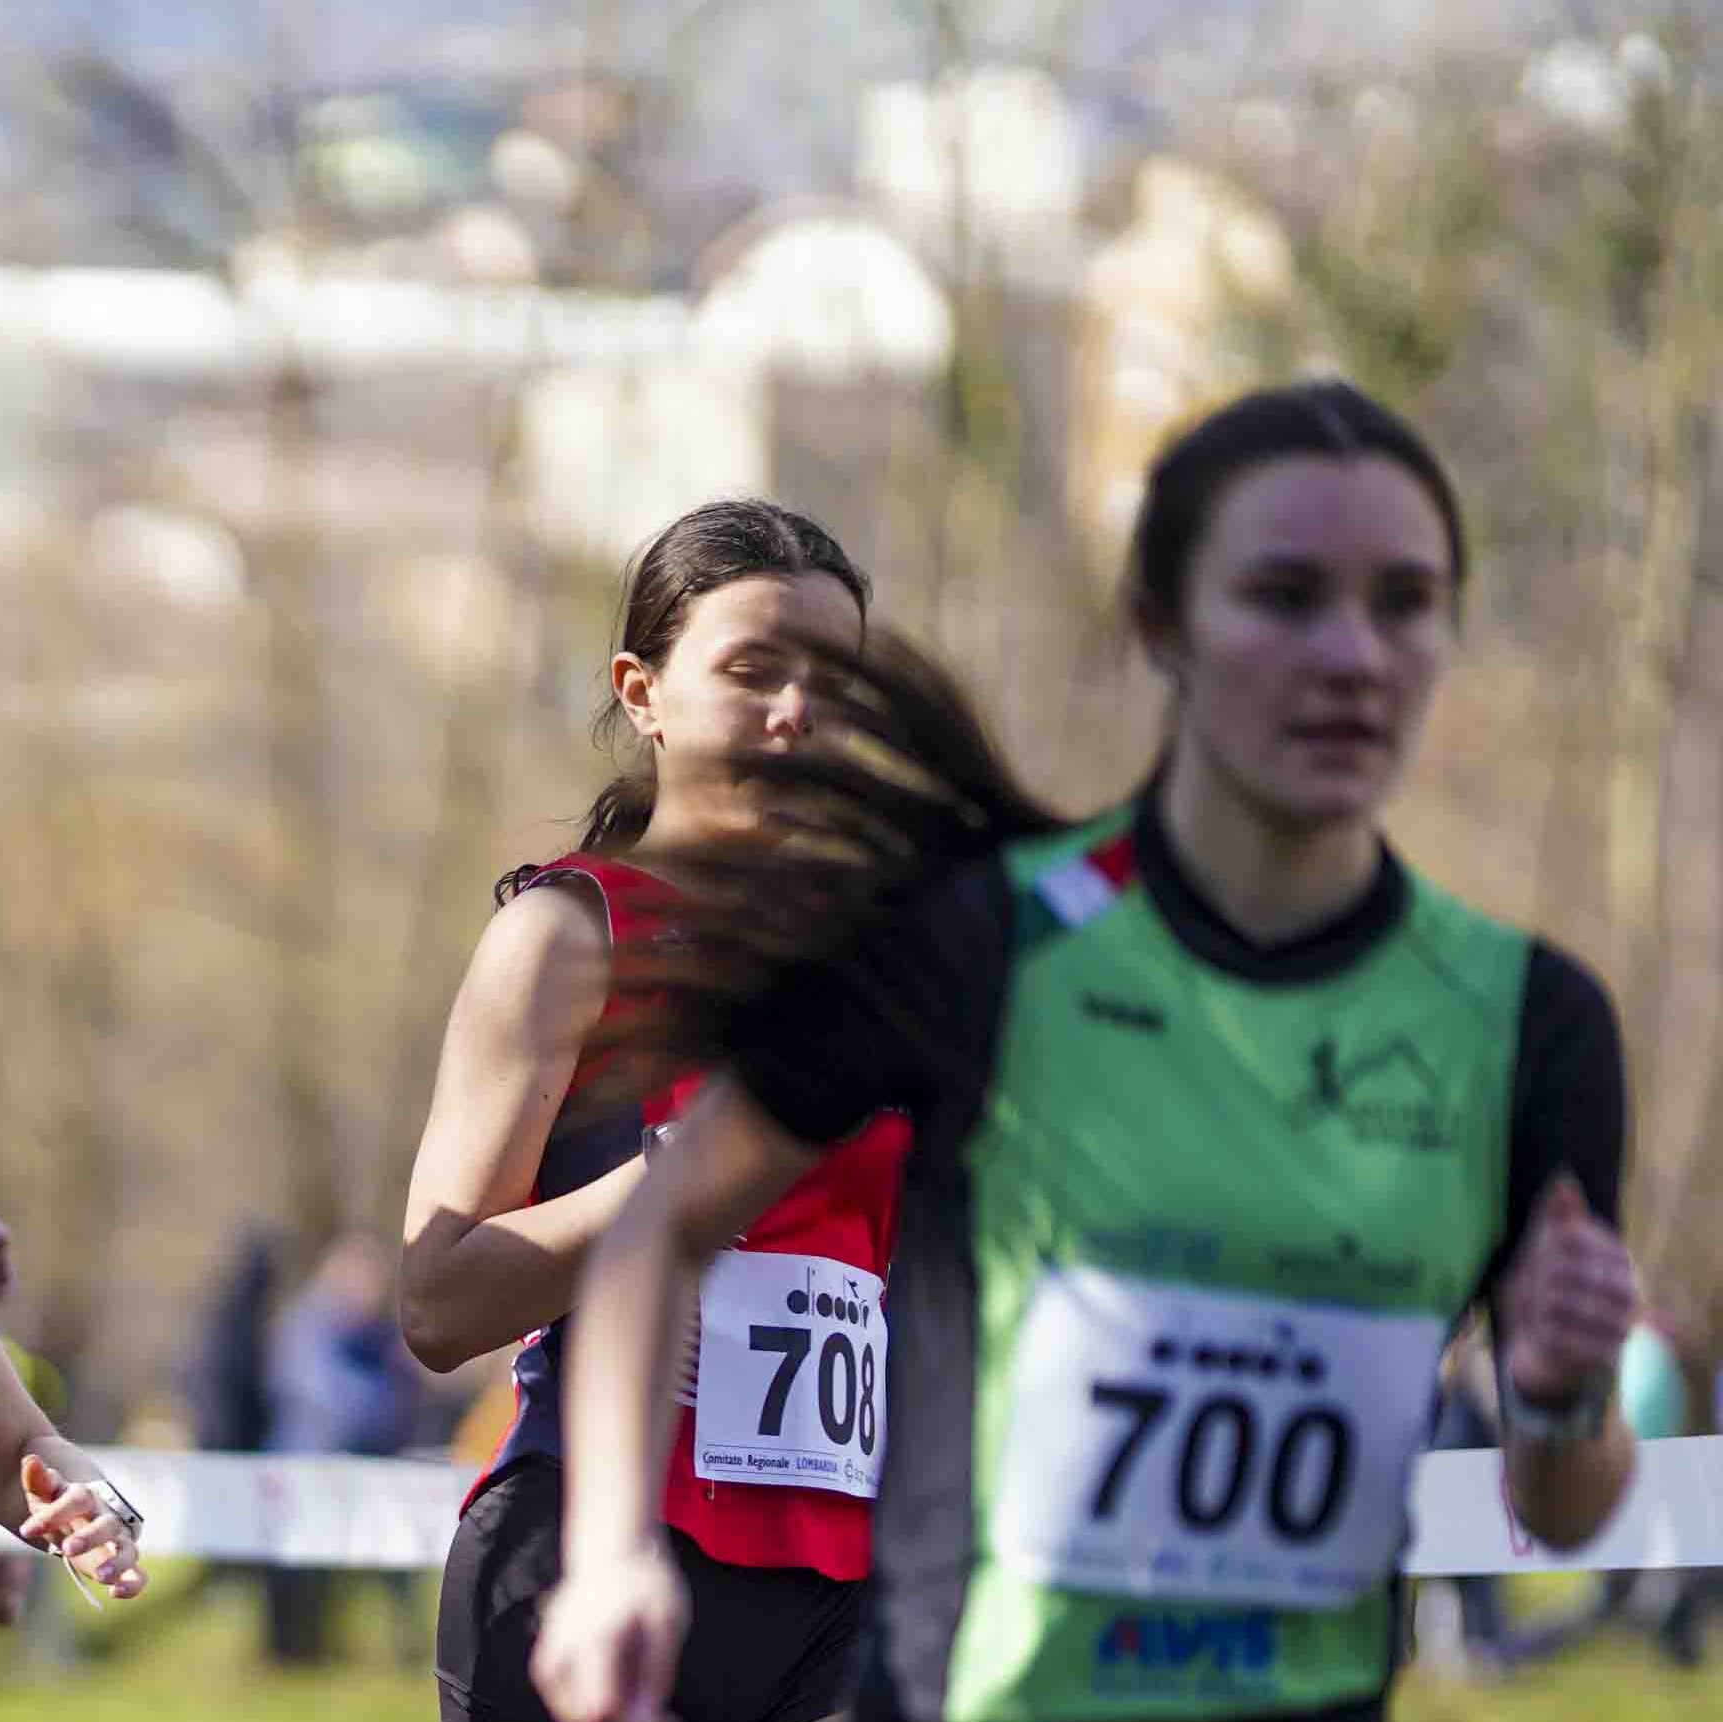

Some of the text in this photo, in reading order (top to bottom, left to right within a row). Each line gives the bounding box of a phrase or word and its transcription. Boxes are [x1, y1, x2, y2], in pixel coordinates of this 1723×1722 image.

[749, 1324, 876, 1456] 708
[702, 1451, 743, 1466] Comitato
[746, 1454, 790, 1471] Regionale
[1091, 1378, 1354, 1546] 700
